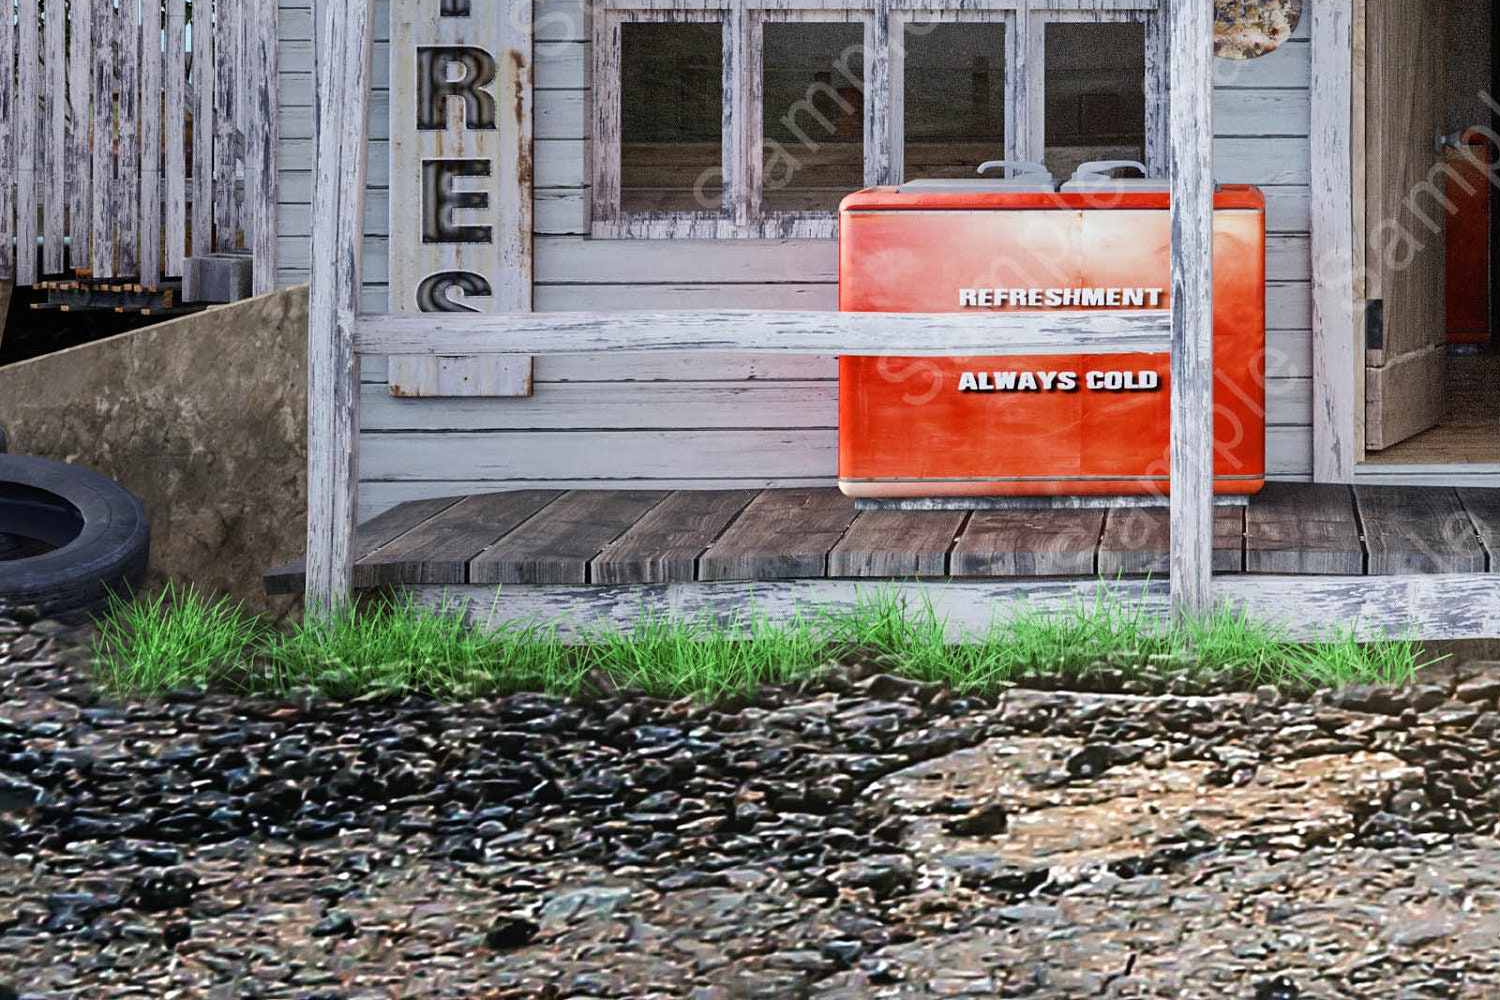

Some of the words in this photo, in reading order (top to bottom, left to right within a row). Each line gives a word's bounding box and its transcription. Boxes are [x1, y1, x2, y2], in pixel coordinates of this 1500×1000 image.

[958, 288, 1163, 307] REFRESHMENT
[958, 371, 1077, 390] ALWAYS
[1086, 370, 1159, 390] COLD
